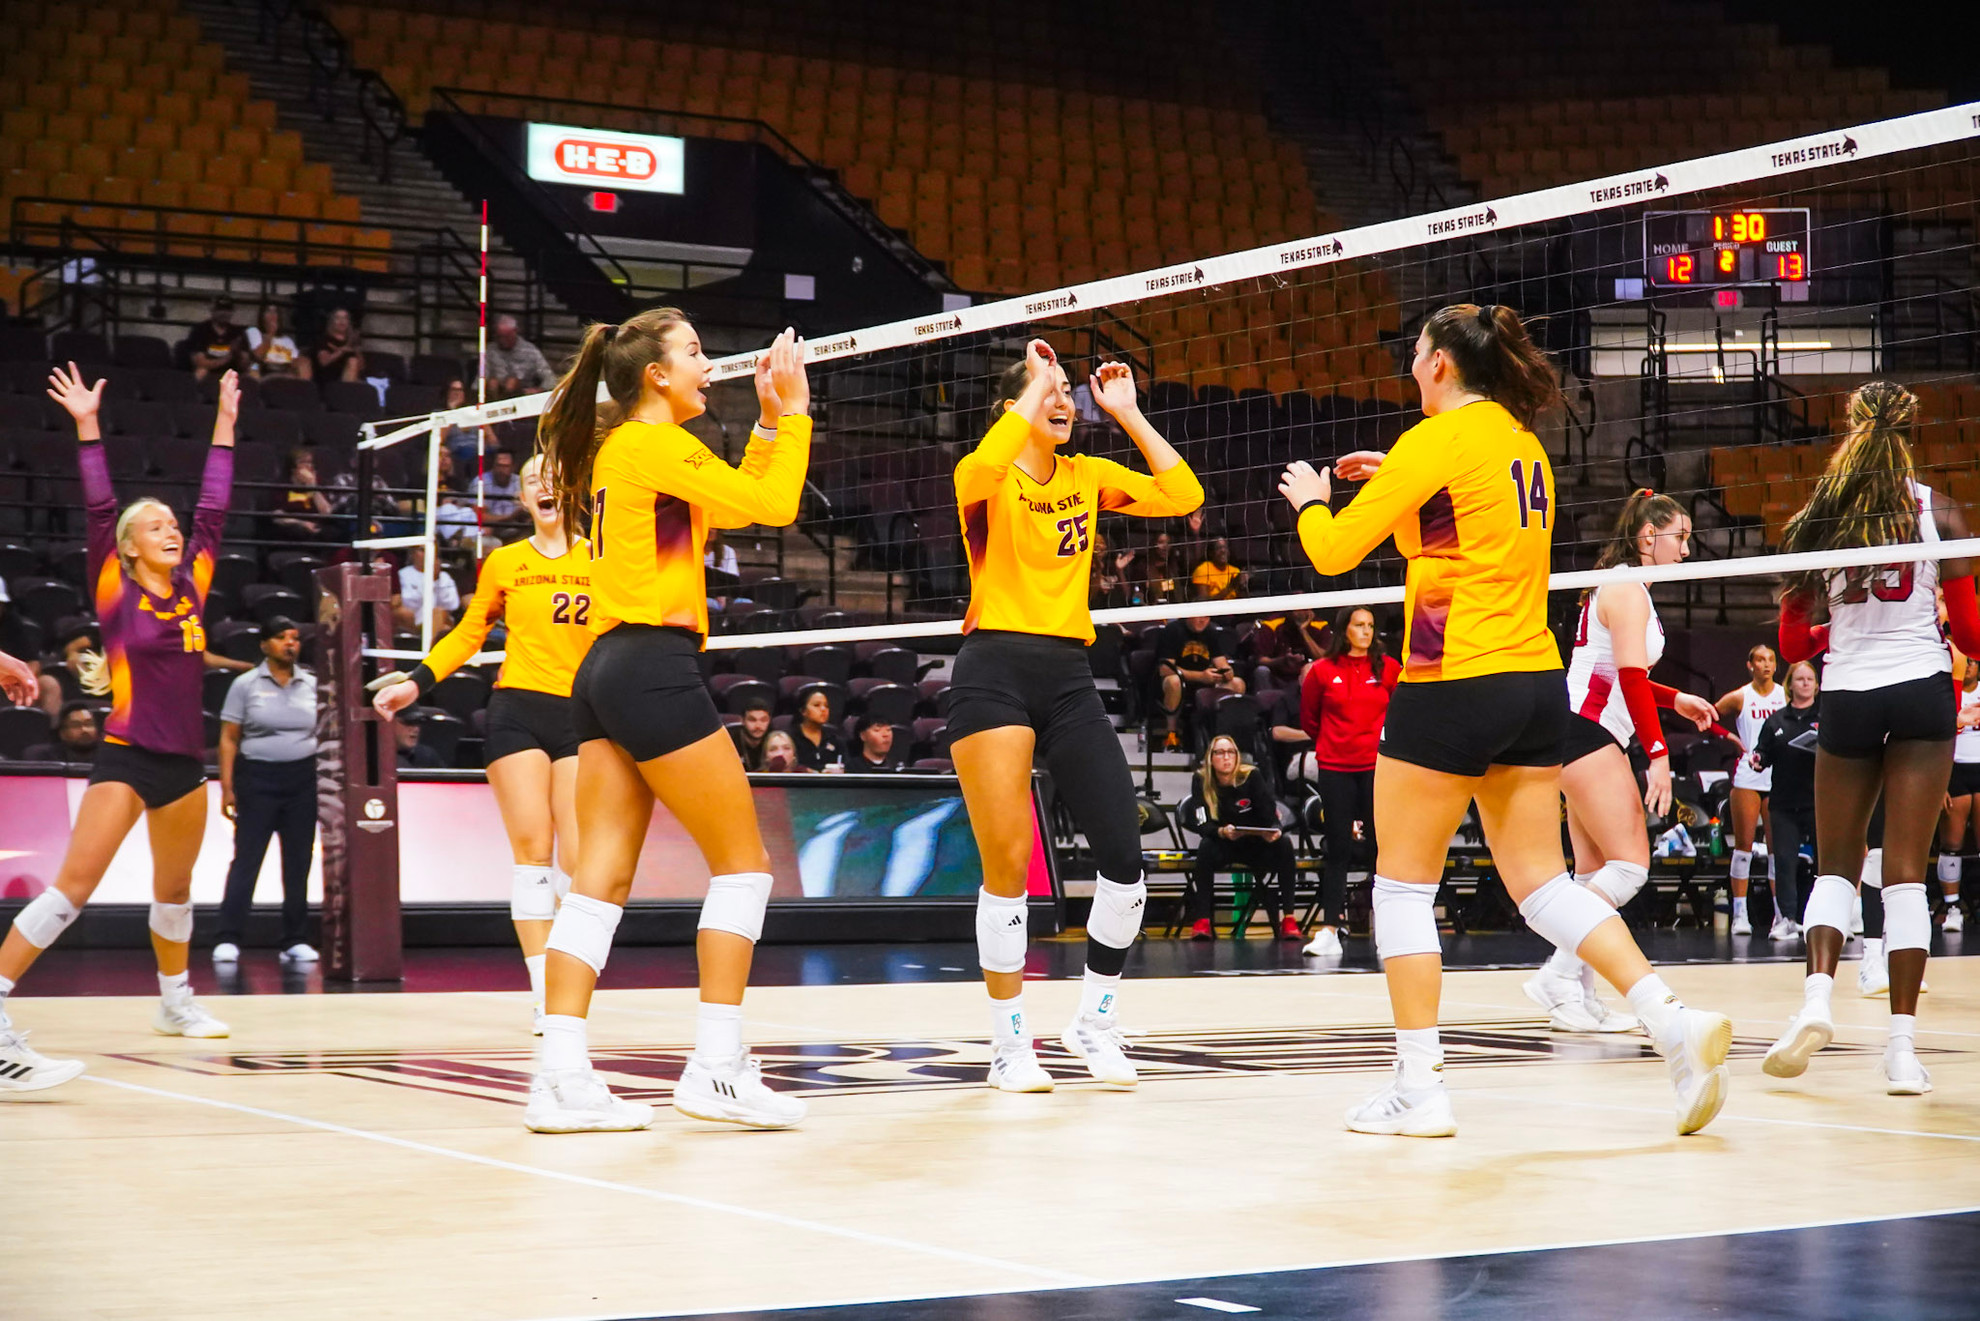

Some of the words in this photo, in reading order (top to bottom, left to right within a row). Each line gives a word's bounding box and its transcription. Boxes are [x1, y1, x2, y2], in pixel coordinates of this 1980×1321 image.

[1771, 149, 1806, 168] TEXAS
[1809, 142, 1841, 161] STATE
[1590, 186, 1622, 203] TEXAS
[1624, 180, 1653, 197] STATE
[1428, 220, 1455, 236] TEXAS
[1458, 214, 1484, 230] STATE
[1714, 213, 1765, 241] 1:30
[1281, 250, 1305, 264] TEXAS
[1307, 244, 1331, 259] STATE
[1653, 244, 1689, 255] HOME
[1766, 241, 1798, 252] GUEST
[1667, 254, 1692, 283] 12
[1719, 250, 1735, 273] 2
[1778, 253, 1803, 281] 13
[1146, 277, 1169, 291] TEXAS
[1171, 272, 1193, 286] STATE
[1025, 303, 1046, 315] TEXAS
[1047, 297, 1067, 310] STATE
[914, 323, 934, 336] TEXAS
[935, 320, 953, 332] STATE
[1510, 458, 1549, 530] 14
[1056, 510, 1089, 557] 25
[514, 574, 557, 587] ARIZONA
[561, 574, 591, 587] STATE
[552, 591, 592, 626] 22
